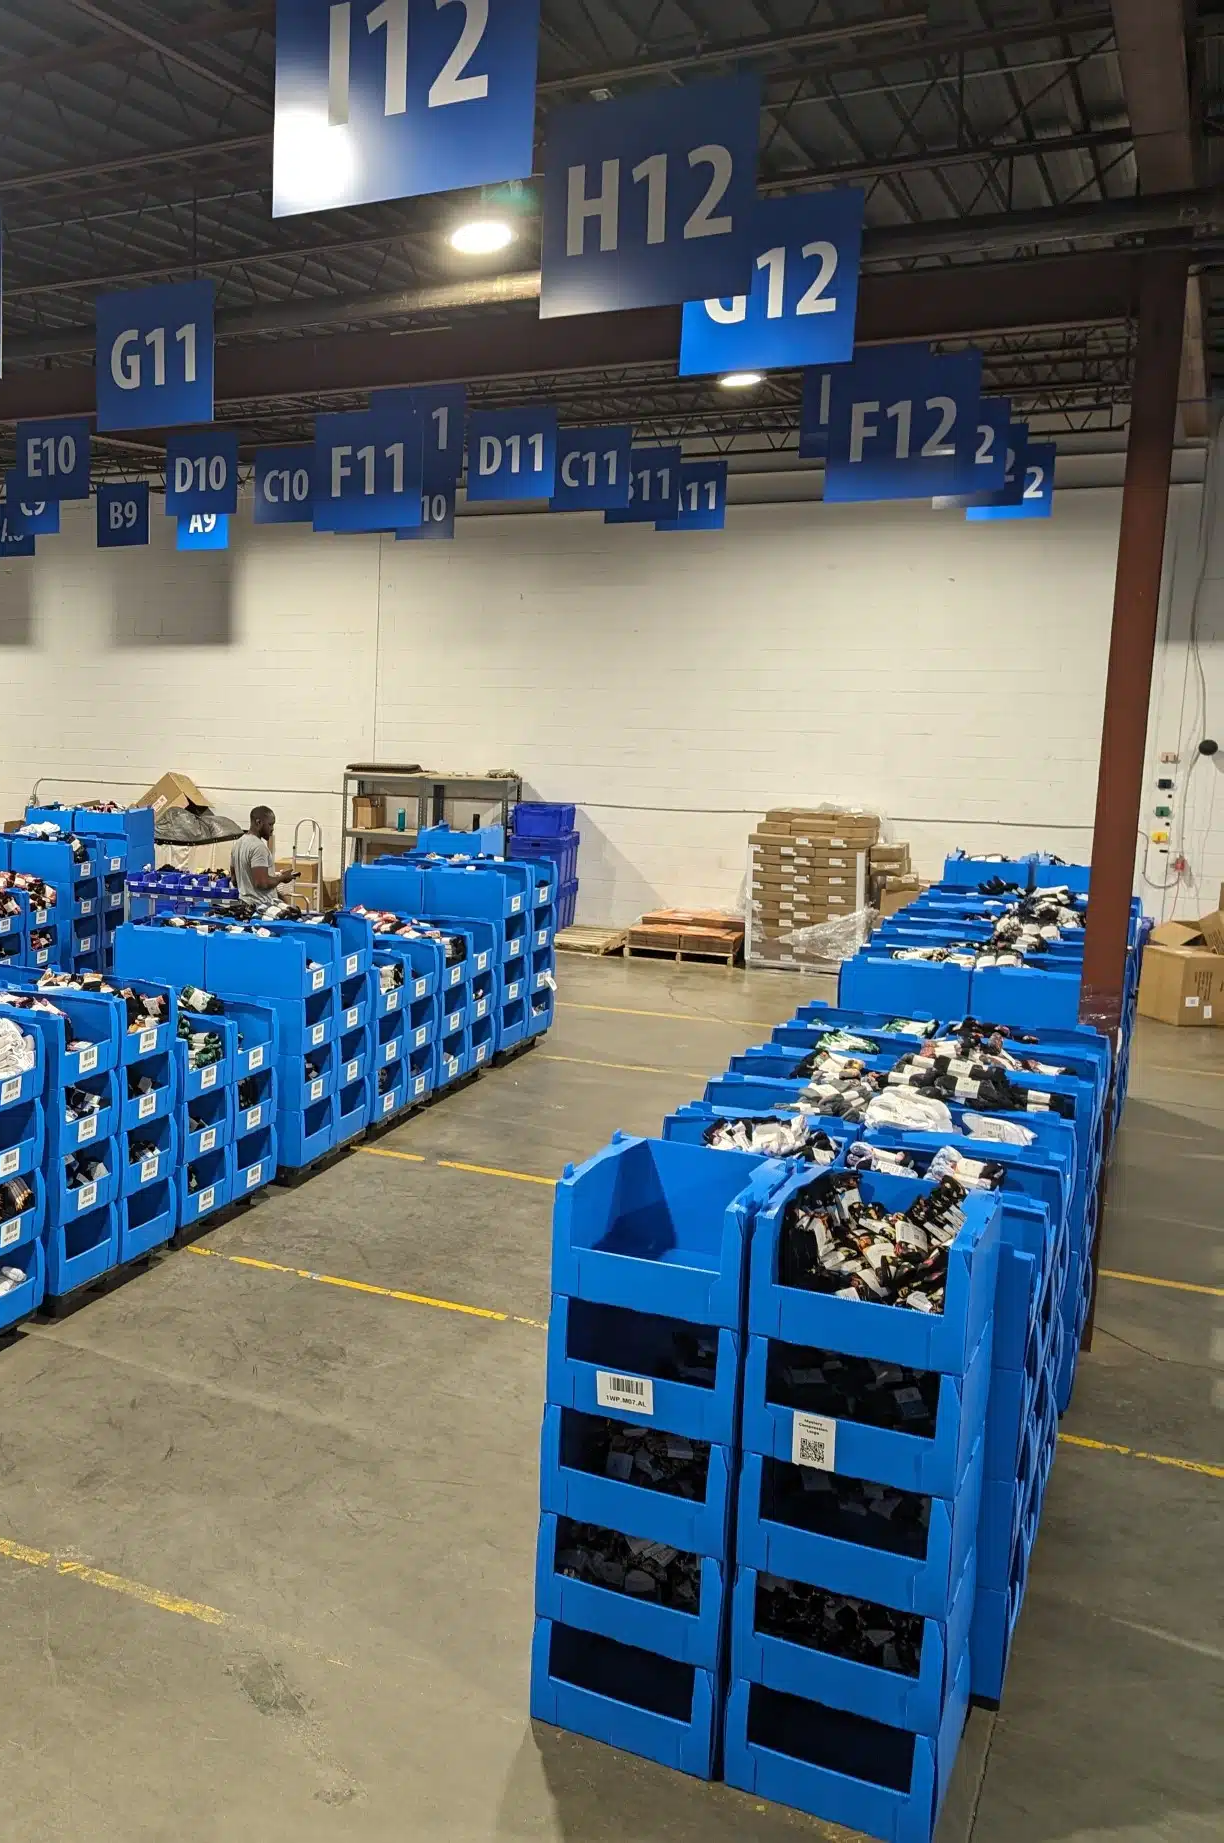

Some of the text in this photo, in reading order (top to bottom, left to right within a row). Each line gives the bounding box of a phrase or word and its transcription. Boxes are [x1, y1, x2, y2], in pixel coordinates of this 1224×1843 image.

[328, 0, 489, 127] I12
[566, 144, 733, 257] H12
[110, 323, 196, 390] G11
[849, 396, 957, 463] F12
[27, 435, 76, 477] E10
[174, 455, 227, 493] D10
[330, 442, 404, 497] F11
[479, 433, 543, 476] D11
[561, 450, 617, 487] C11
[263, 468, 309, 502] C10
[109, 501, 137, 529] B9
[188, 513, 216, 533] A9
[421, 494, 447, 521] 10
